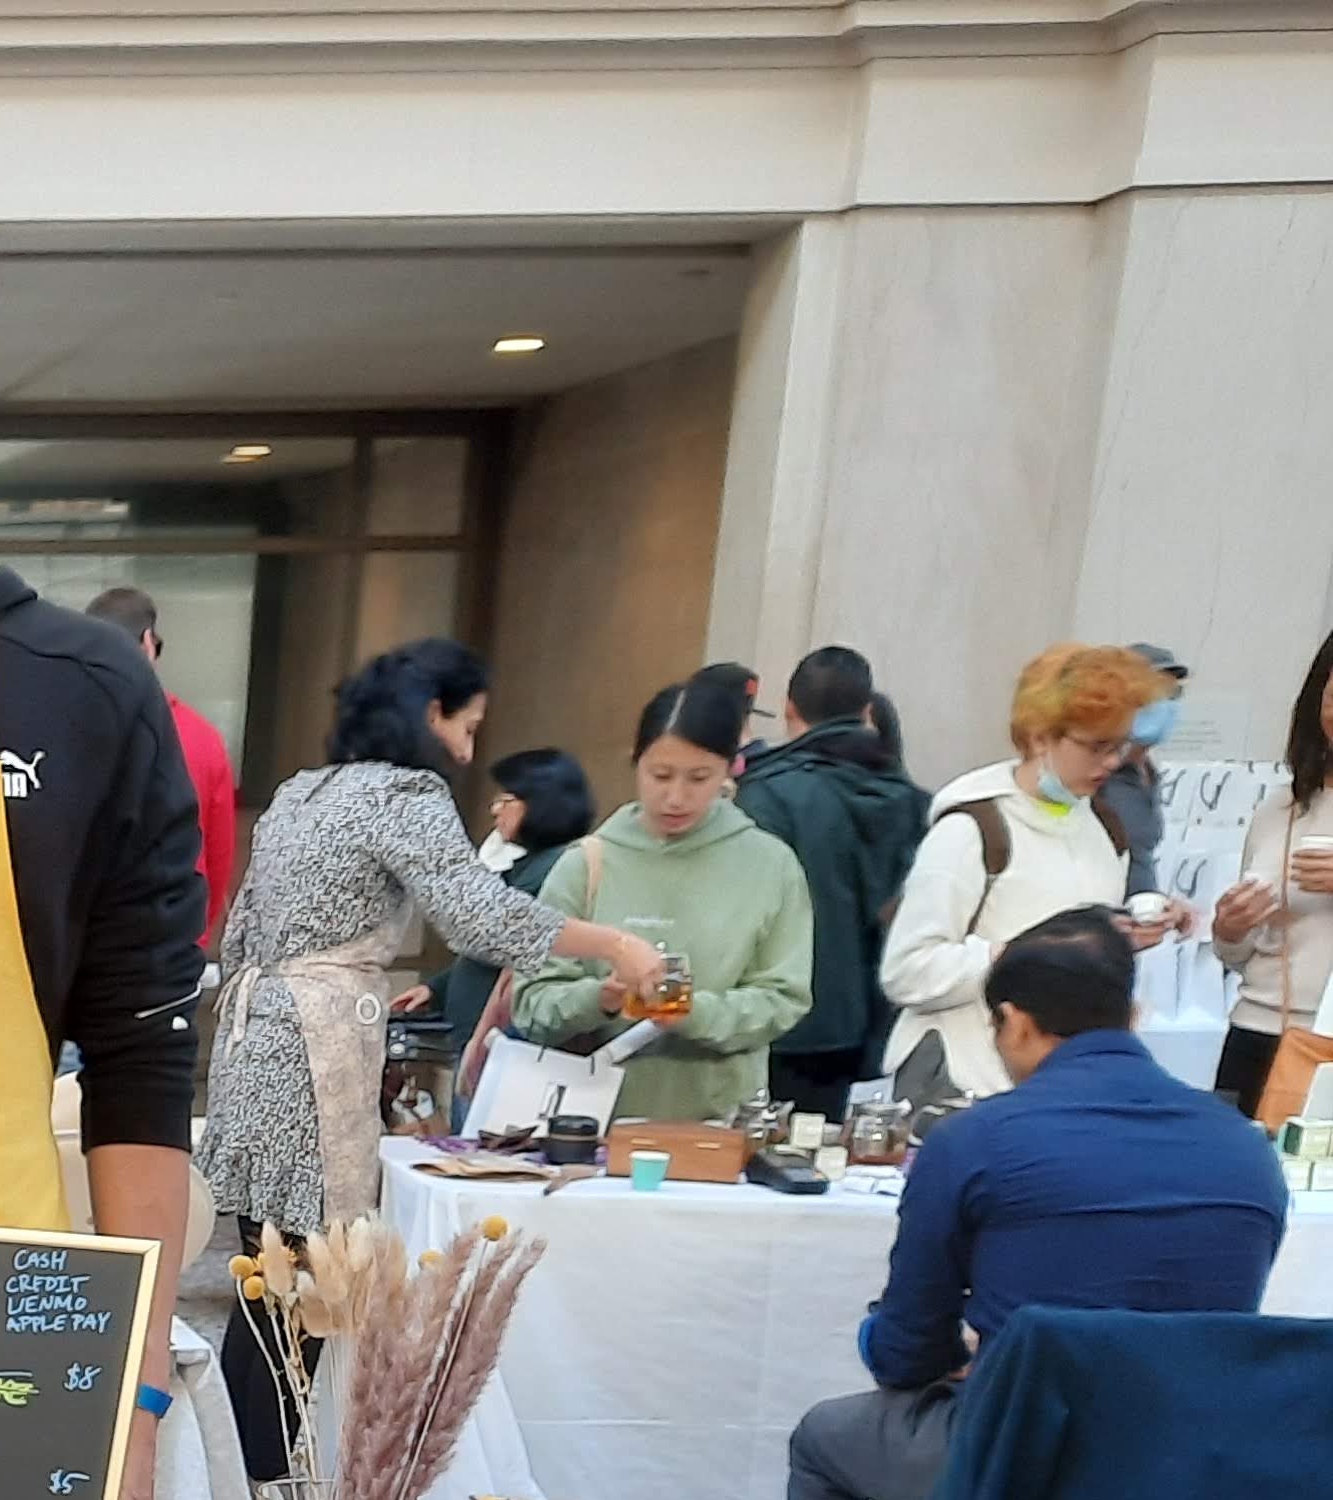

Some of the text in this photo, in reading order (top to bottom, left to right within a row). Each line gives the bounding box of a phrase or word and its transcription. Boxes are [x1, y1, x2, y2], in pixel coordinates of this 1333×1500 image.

[14, 1249, 68, 1271] CASH
[5, 1275, 91, 1293] CREDIT
[6, 1312, 111, 1333] APPLE PAY
[64, 1362, 102, 1390] $8
[49, 1469, 90, 1494] $5
